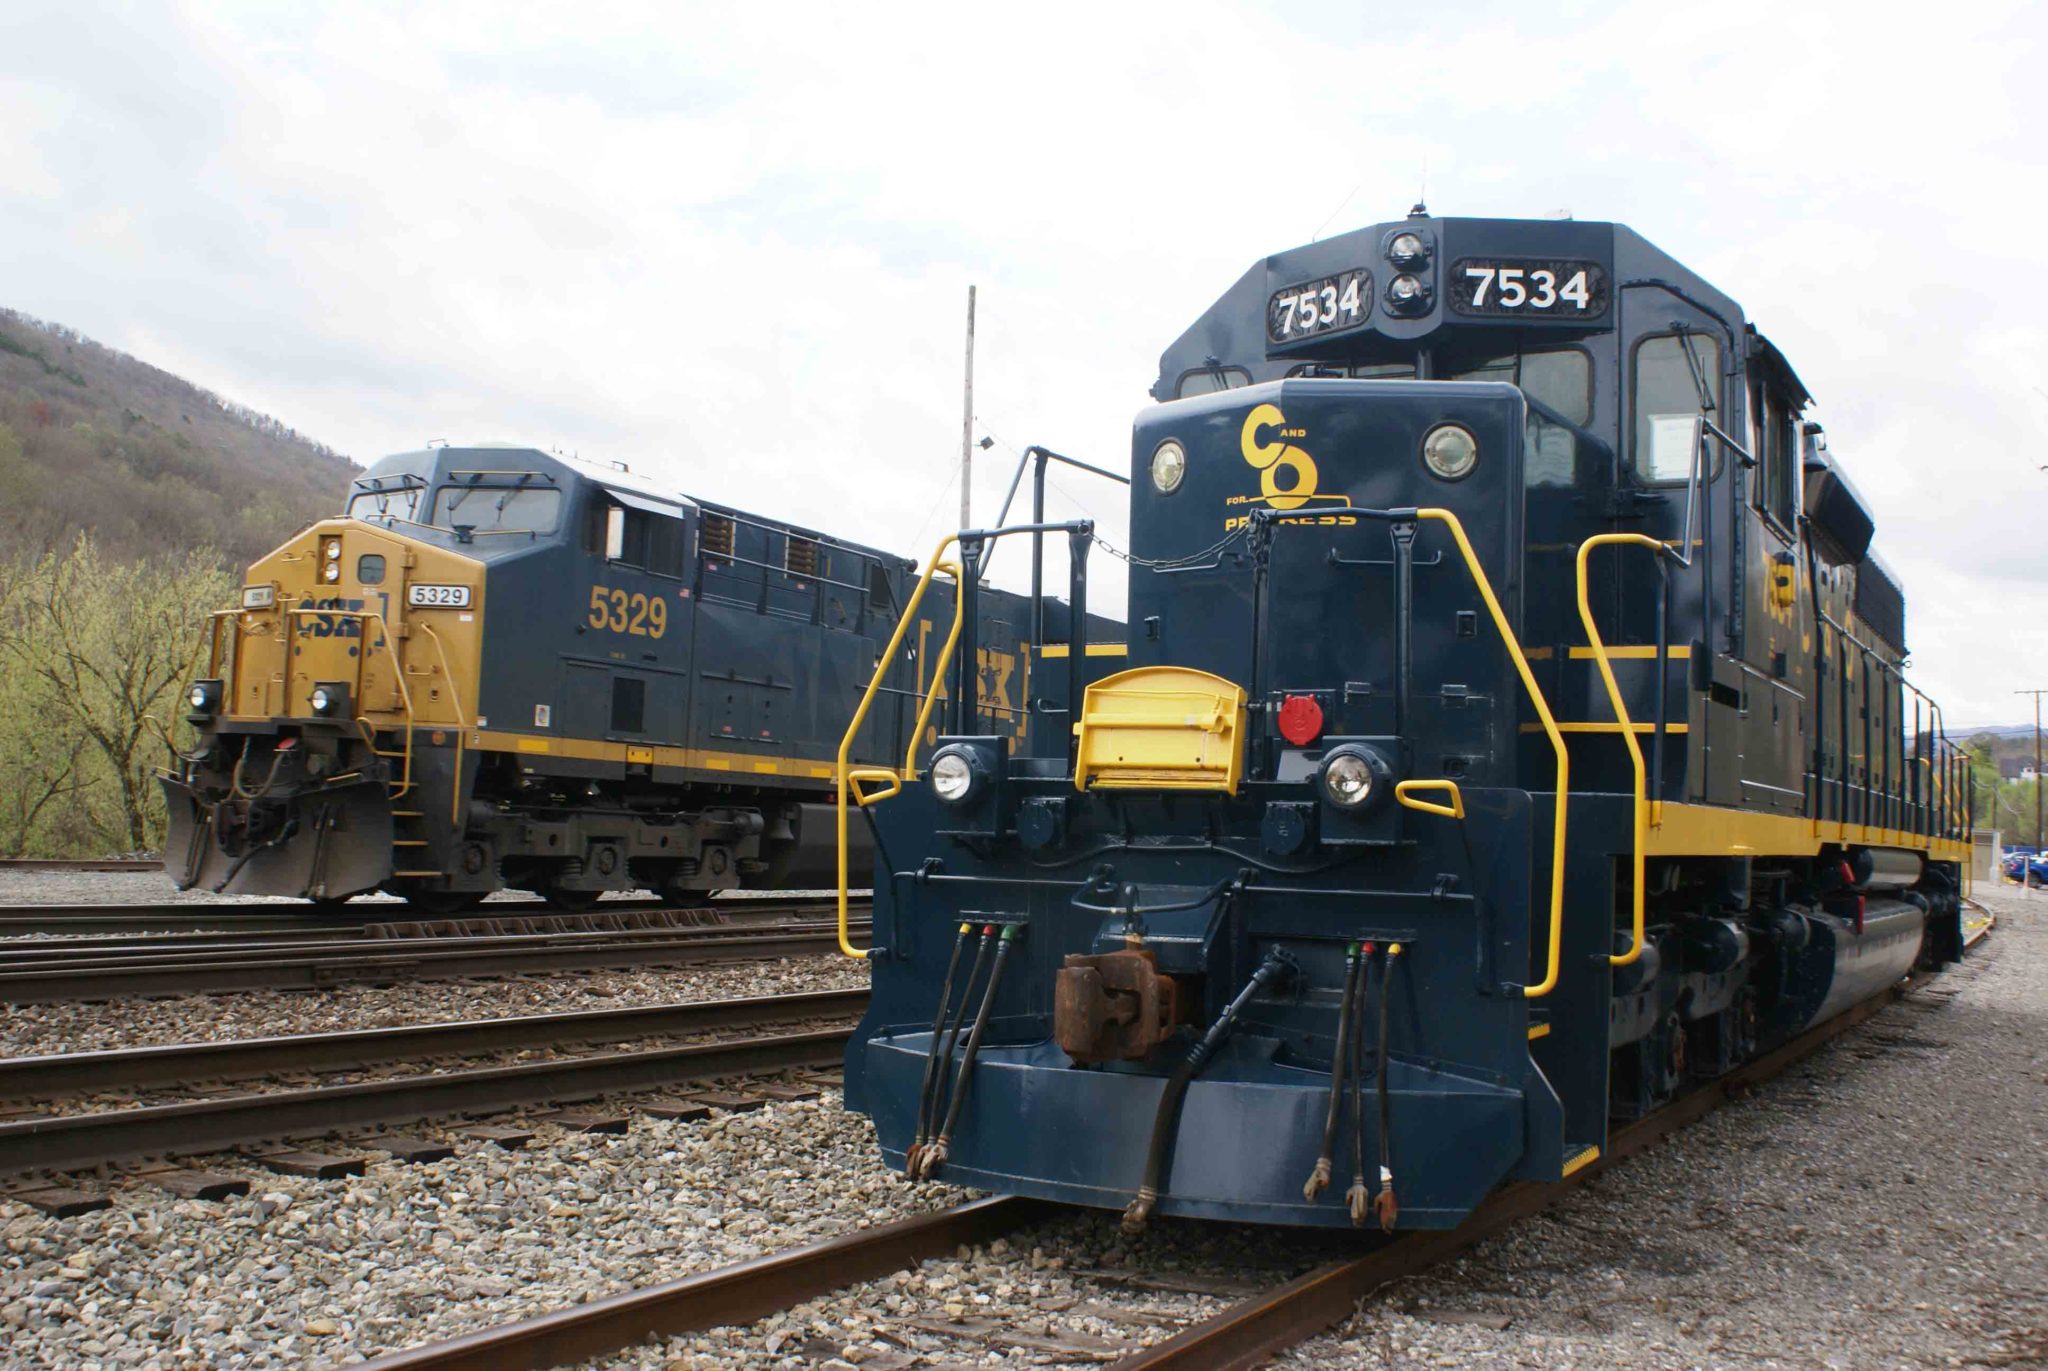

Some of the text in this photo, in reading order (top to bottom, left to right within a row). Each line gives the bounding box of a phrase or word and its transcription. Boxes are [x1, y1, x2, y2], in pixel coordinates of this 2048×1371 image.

[1279, 279, 1360, 334] 7534
[1465, 268, 1589, 309] 7534
[1241, 403, 1286, 468] C
[1280, 429, 1307, 437] AND
[1261, 445, 1318, 510] O
[1226, 496, 1248, 506] FOR
[1225, 516, 1357, 531] PRRESS
[415, 587, 463, 604] 5329
[588, 585, 667, 639] 5329
